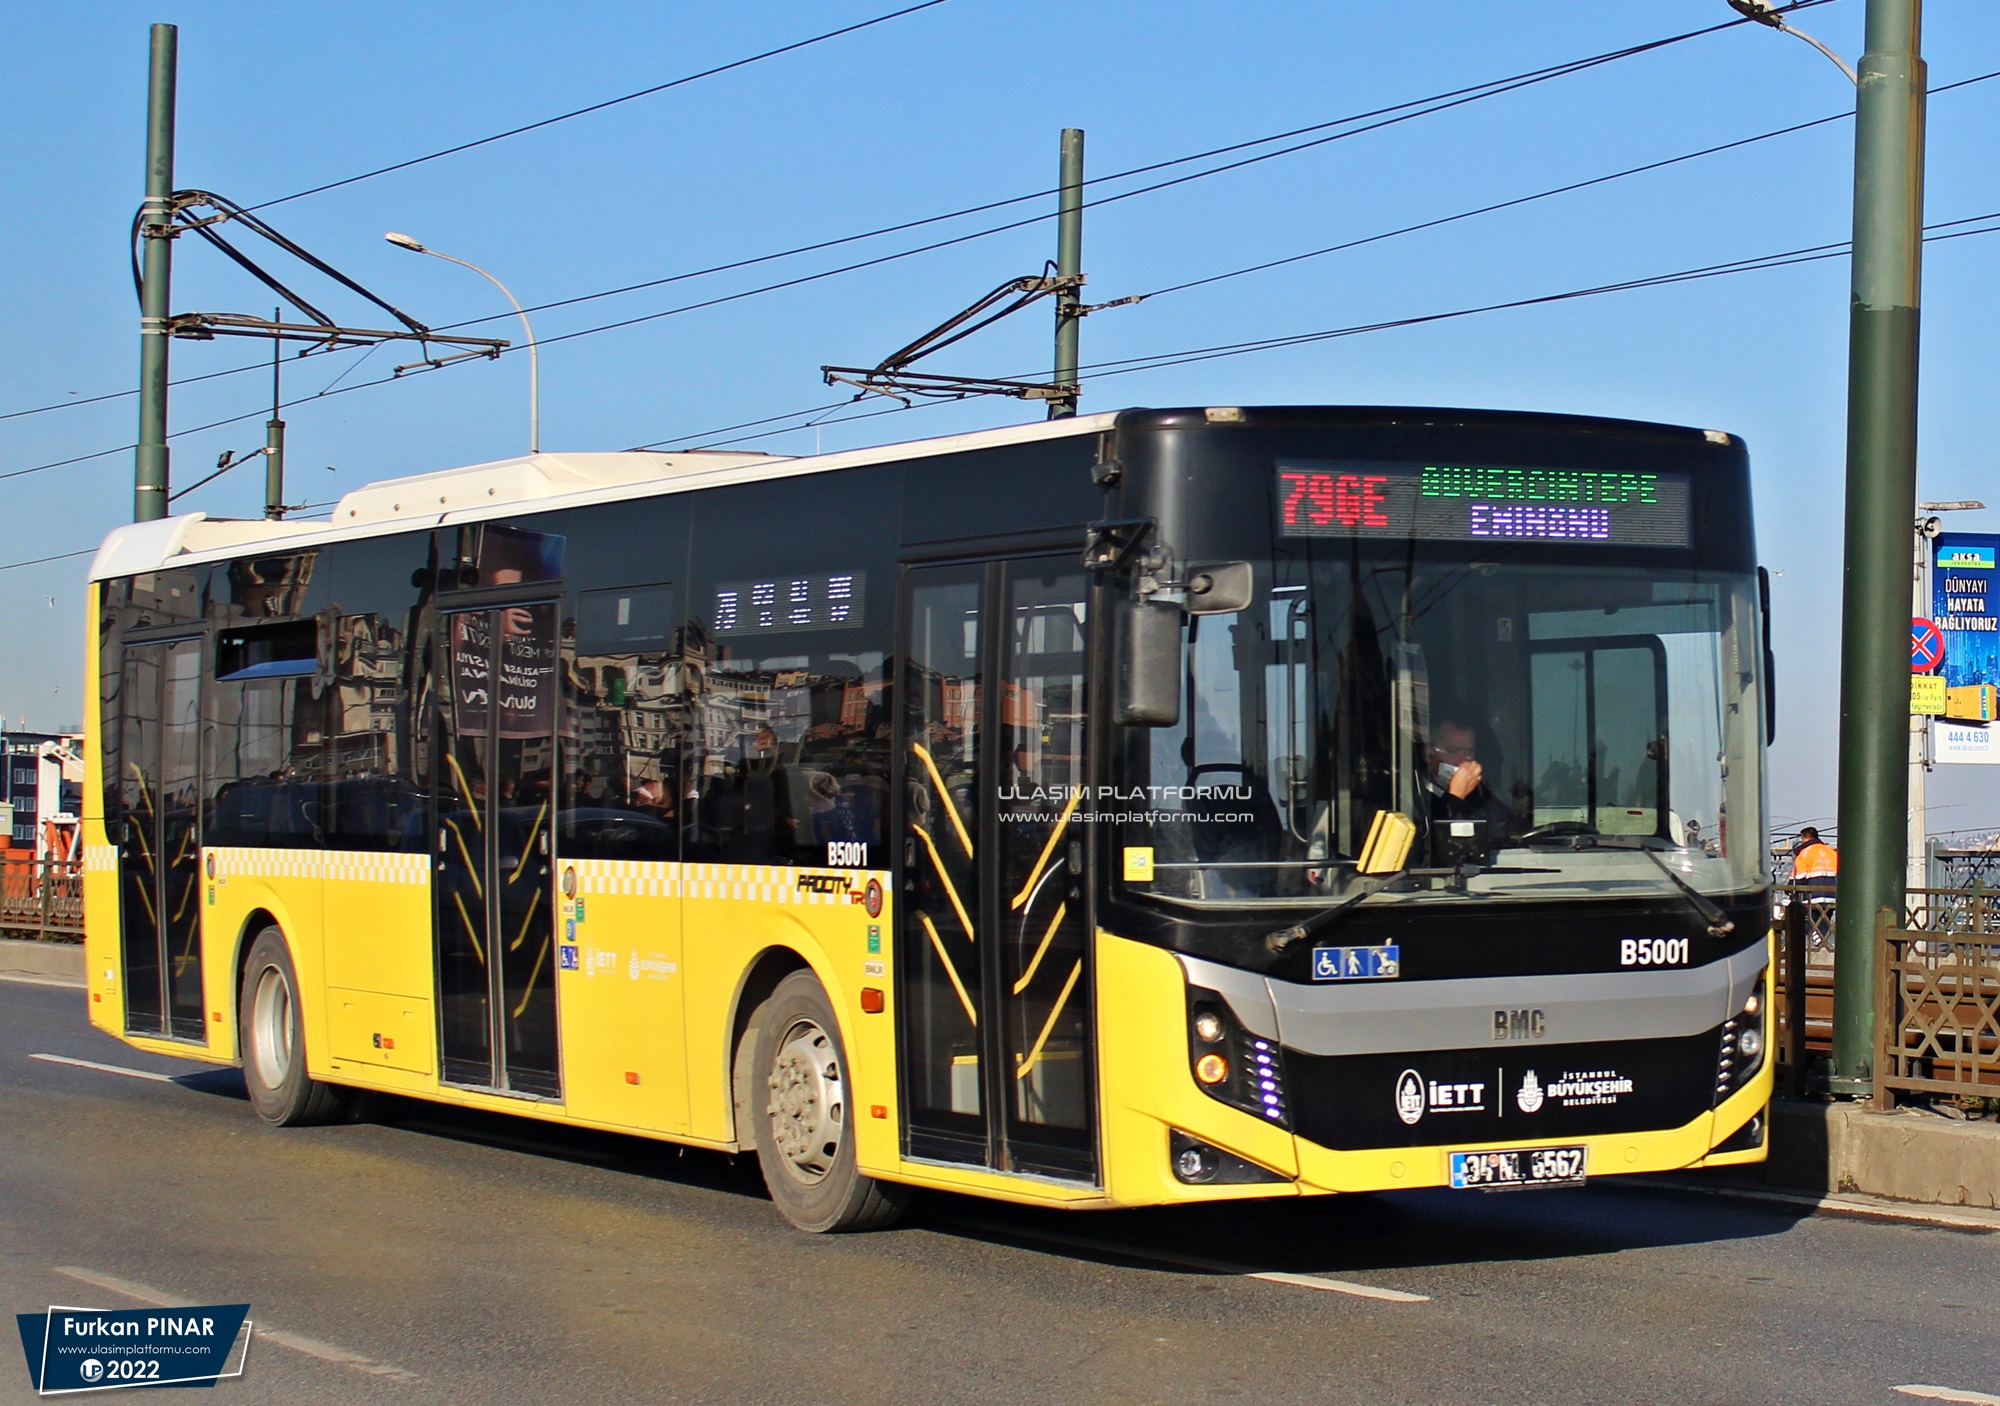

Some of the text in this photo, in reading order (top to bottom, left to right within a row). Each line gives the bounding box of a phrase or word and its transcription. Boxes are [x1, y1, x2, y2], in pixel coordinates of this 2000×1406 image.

[1952, 552, 1980, 562] aksa
[1945, 576, 1987, 593] DÜNYAYI
[1947, 598, 1985, 612] HAYATA
[1934, 614, 1998, 631] BAĞLIYORUZ
[1948, 731, 1989, 743] 444 4 630
[827, 841, 868, 867] B5001
[797, 875, 853, 894] PROCITY
[1620, 938, 1689, 966] B5001
[1493, 1009, 1546, 1041] BMC
[1562, 1070, 1617, 1080] İSTANBUL
[1547, 1076, 1633, 1098] BÜYÜKŞEHİR
[1562, 1095, 1617, 1107] BELEDİYESİ
